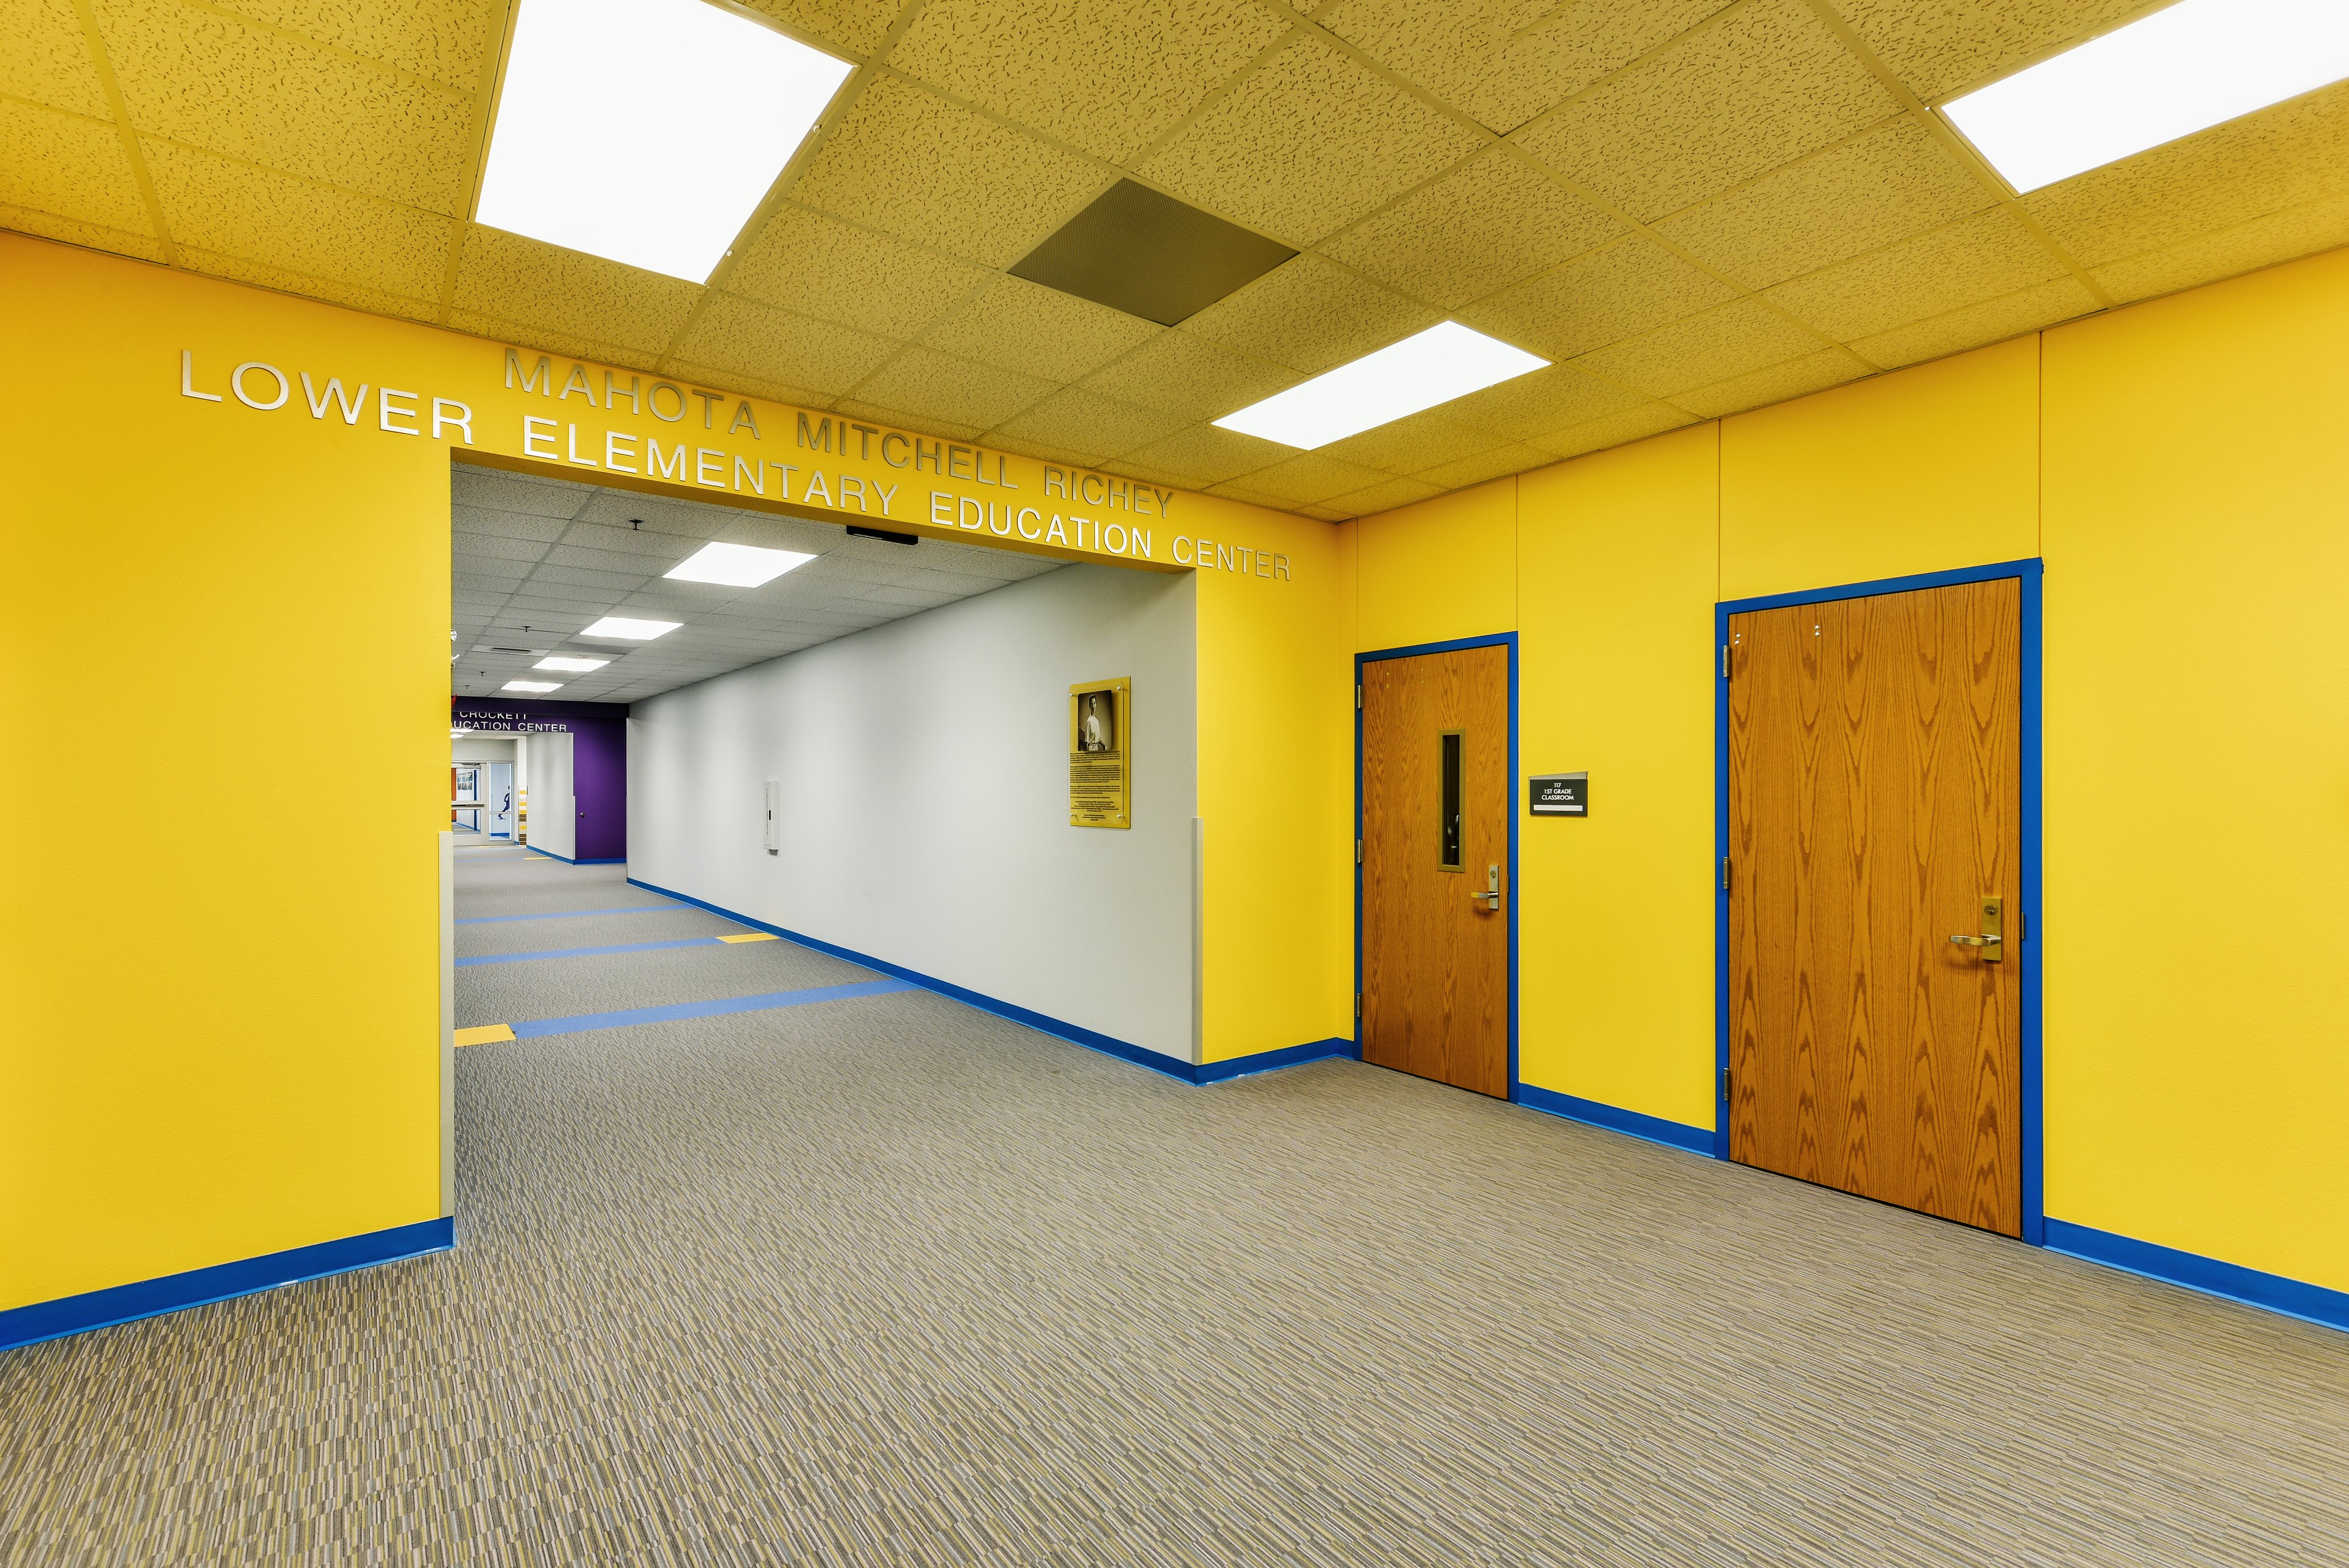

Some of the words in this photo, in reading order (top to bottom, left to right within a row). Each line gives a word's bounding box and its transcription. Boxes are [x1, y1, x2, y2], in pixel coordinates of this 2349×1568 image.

[181, 349, 473, 445] LOWER
[523, 414, 900, 516] ELEMENTARY
[930, 490, 1152, 559] EDUCATION
[1172, 535, 1291, 582] CENTER
[505, 347, 761, 440] MAHOTA
[797, 411, 1018, 490] MITCHELL
[1044, 465, 1173, 519] RICHEY
[451, 720, 510, 730] UCATION
[518, 723, 567, 732] CENTER
